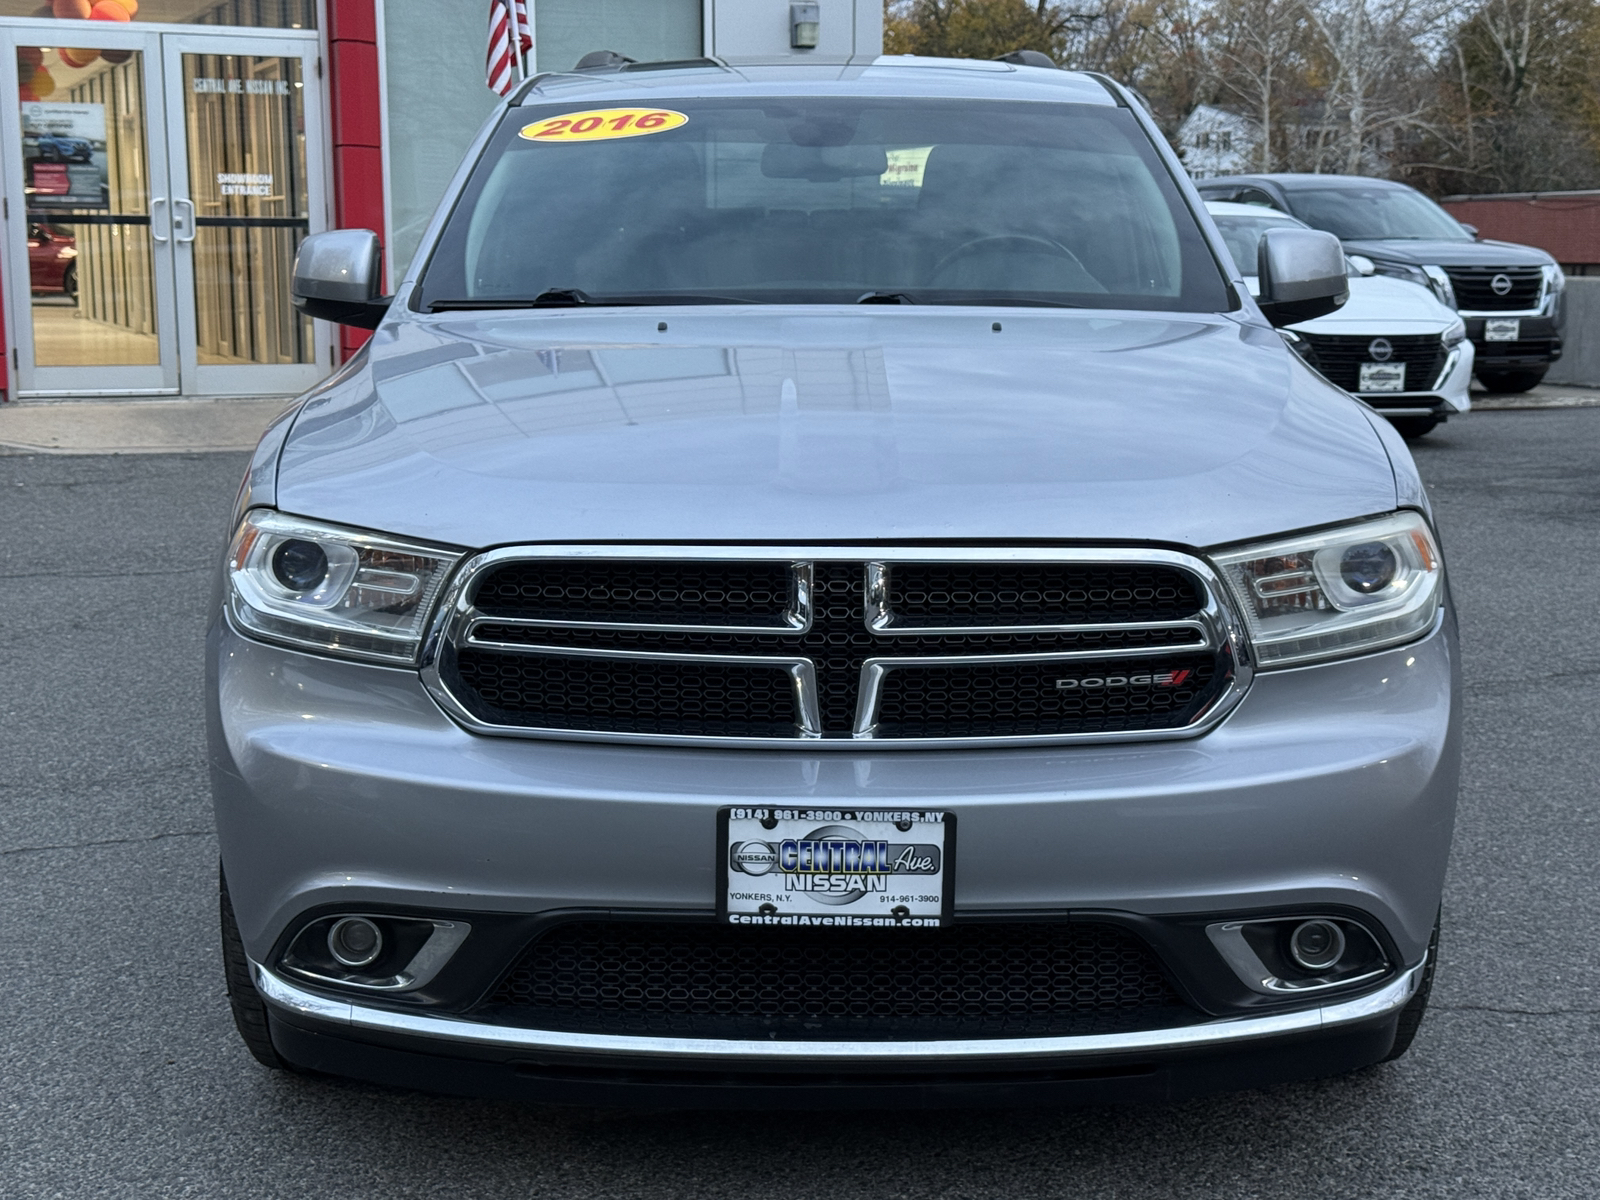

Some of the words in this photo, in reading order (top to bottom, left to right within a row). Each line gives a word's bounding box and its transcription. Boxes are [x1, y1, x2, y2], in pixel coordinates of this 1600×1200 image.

[533, 112, 670, 138] 2016
[217, 173, 273, 184] SHOWROOM
[221, 184, 271, 196] ENTRANCE
[1055, 673, 1174, 689] DODGE
[774, 809, 842, 821] 961-3900
[737, 854, 775, 862] NISSAN
[779, 839, 892, 874] CENTRAL
[893, 845, 935, 871] Ave.
[785, 873, 887, 892] NISSAN
[729, 892, 774, 902] YONKERS,
[776, 894, 793, 902] N.Y.
[880, 895, 940, 903] 914-961-3900
[729, 914, 940, 927] CentralAveNissan.com
